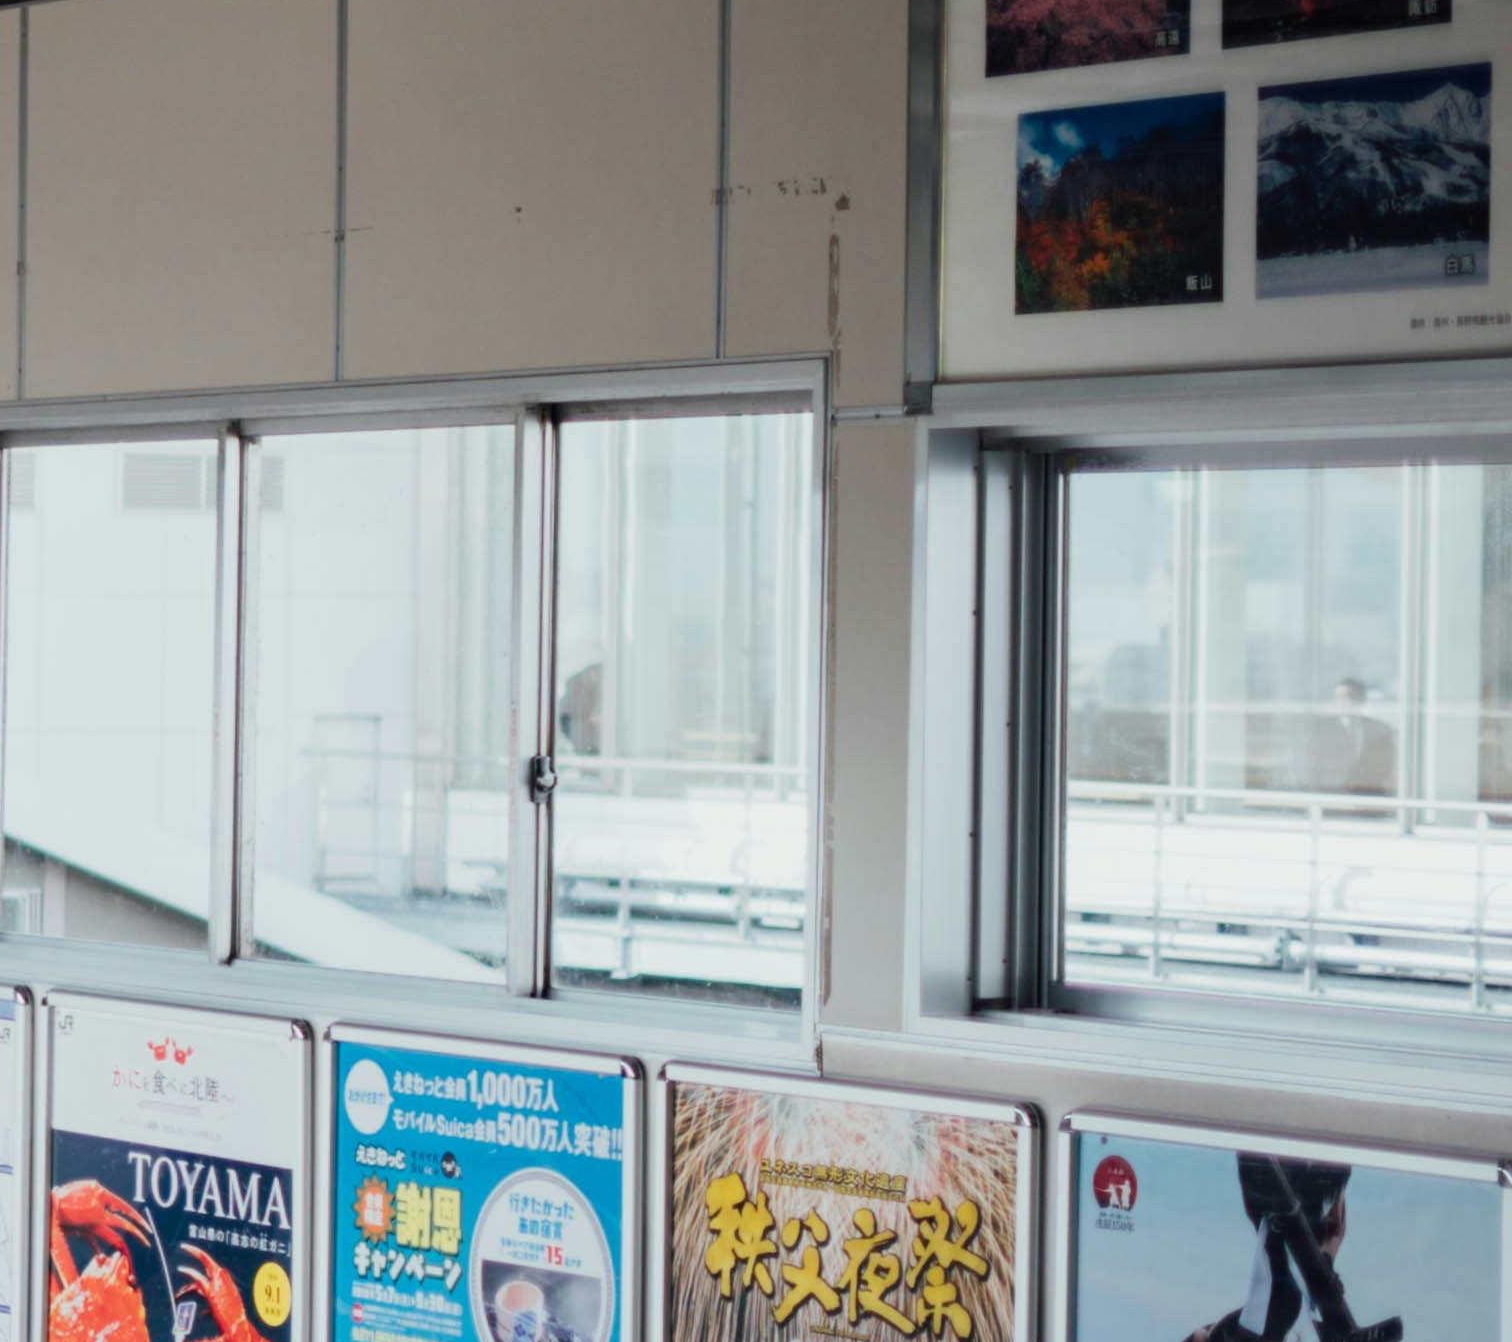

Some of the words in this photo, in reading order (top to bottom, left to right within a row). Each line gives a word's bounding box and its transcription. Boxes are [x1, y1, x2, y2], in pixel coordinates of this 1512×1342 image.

[354, 1143, 408, 1171] えきねっと
[126, 1150, 292, 1230] TOYAMA
[760, 1160, 907, 1194] ユネスコ無形文化遺産
[507, 1192, 576, 1222] 行きたかった
[352, 1241, 463, 1293] キャンペーン
[546, 1245, 564, 1267] 15
[704, 1171, 990, 1341] 秩父夜祭
[263, 1281, 282, 1307] 9.1
